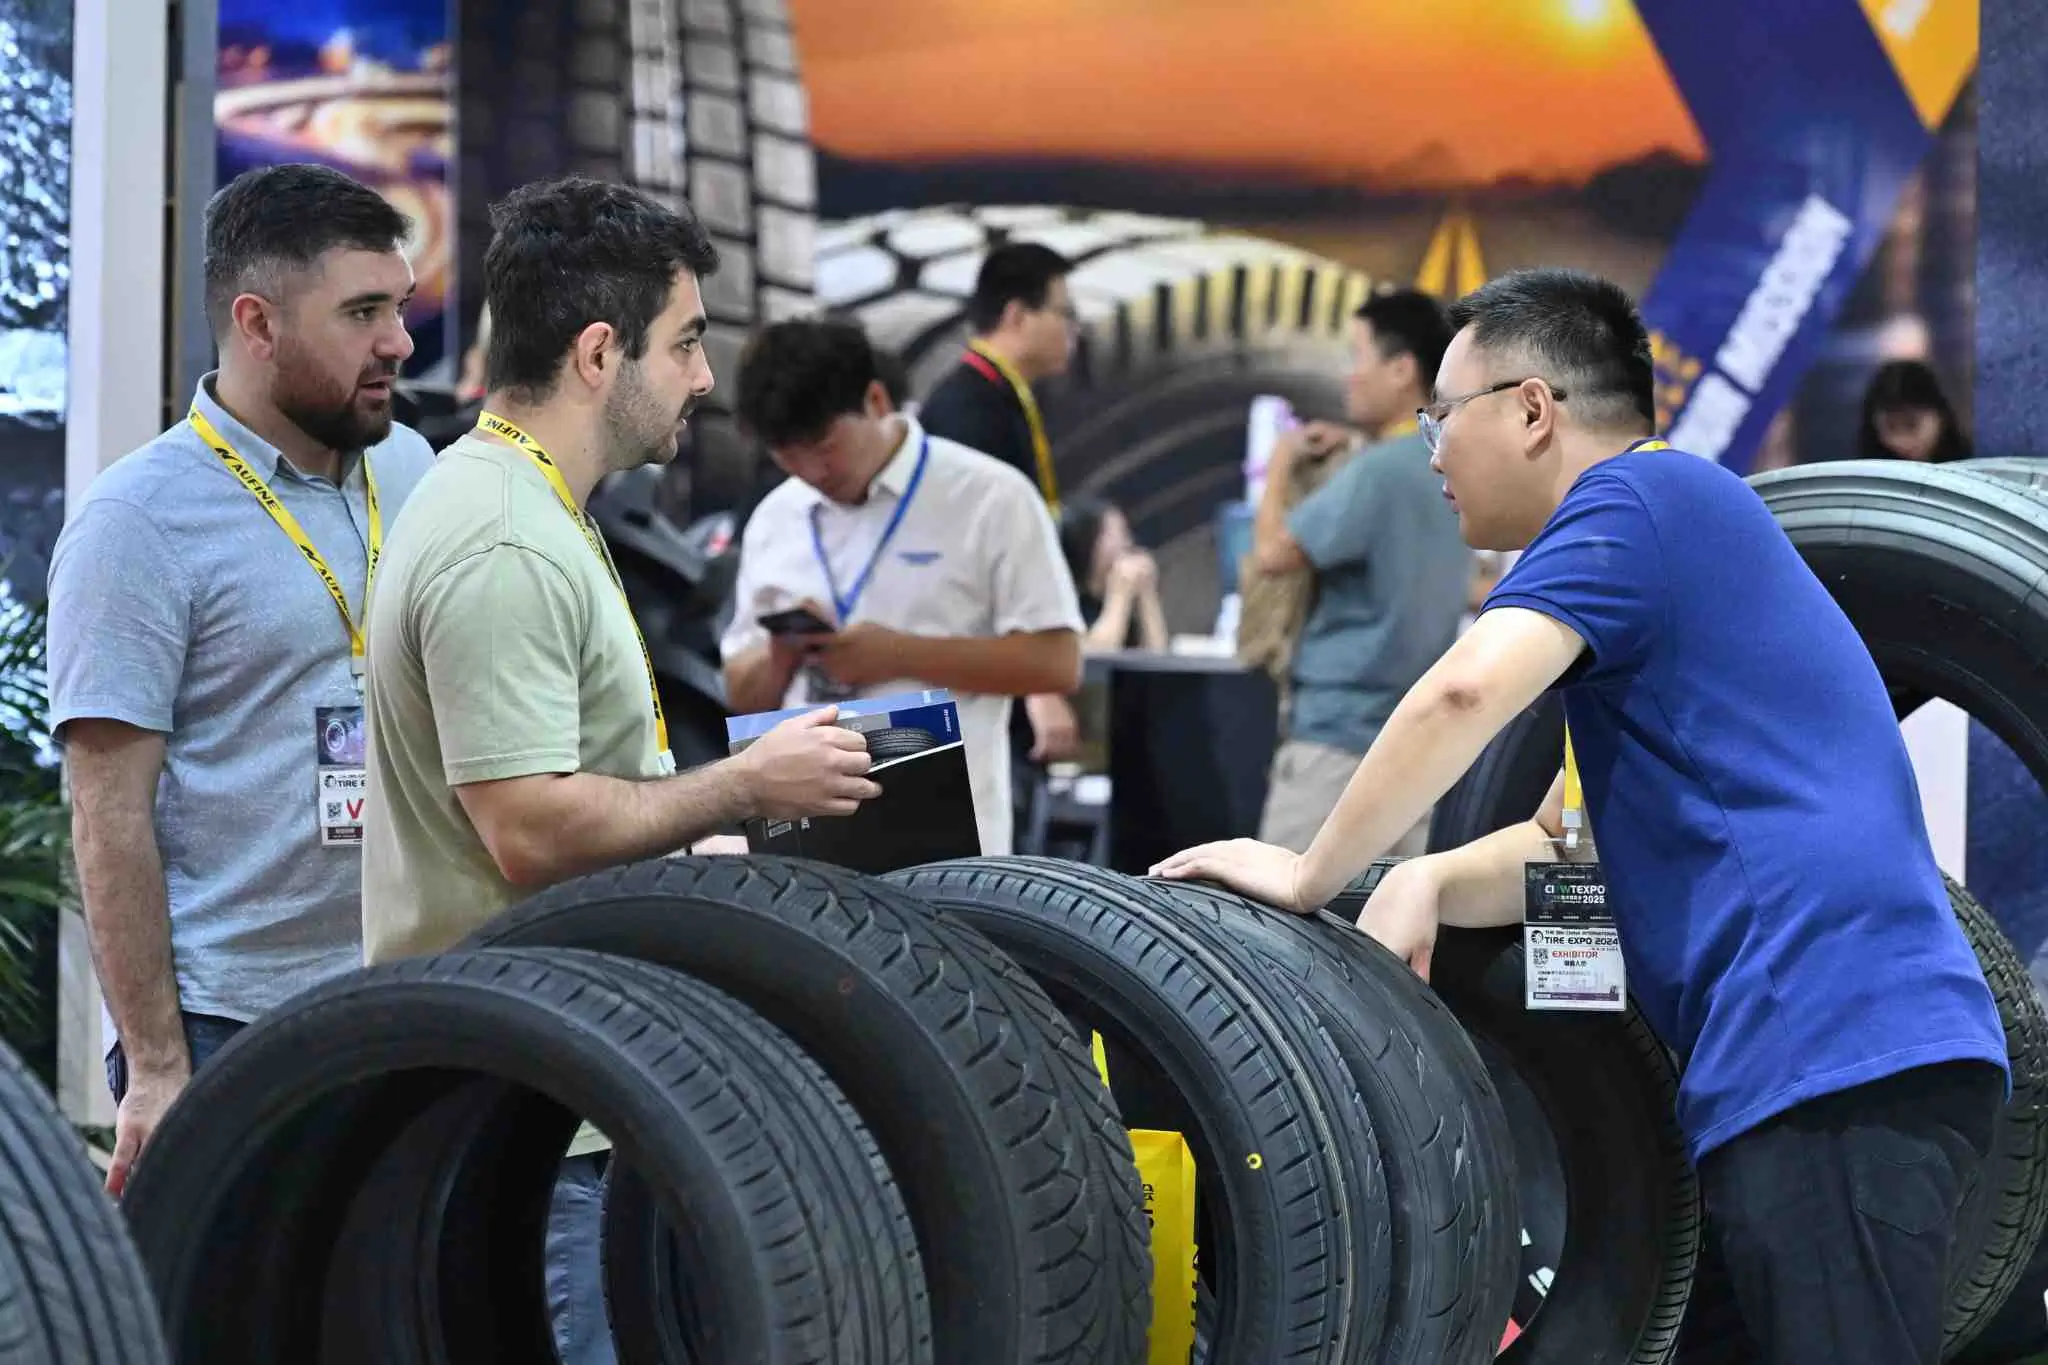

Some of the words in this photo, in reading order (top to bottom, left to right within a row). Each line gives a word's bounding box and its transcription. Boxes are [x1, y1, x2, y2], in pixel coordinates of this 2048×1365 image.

[231, 463, 281, 511] AUFINE
[1544, 884, 1606, 895] CIWTEXPO
[1544, 936, 1565, 945] TIRE
[1568, 936, 1592, 945] EXPO
[1595, 936, 1618, 945] 2024
[1552, 950, 1599, 958] EXHIBITOR
